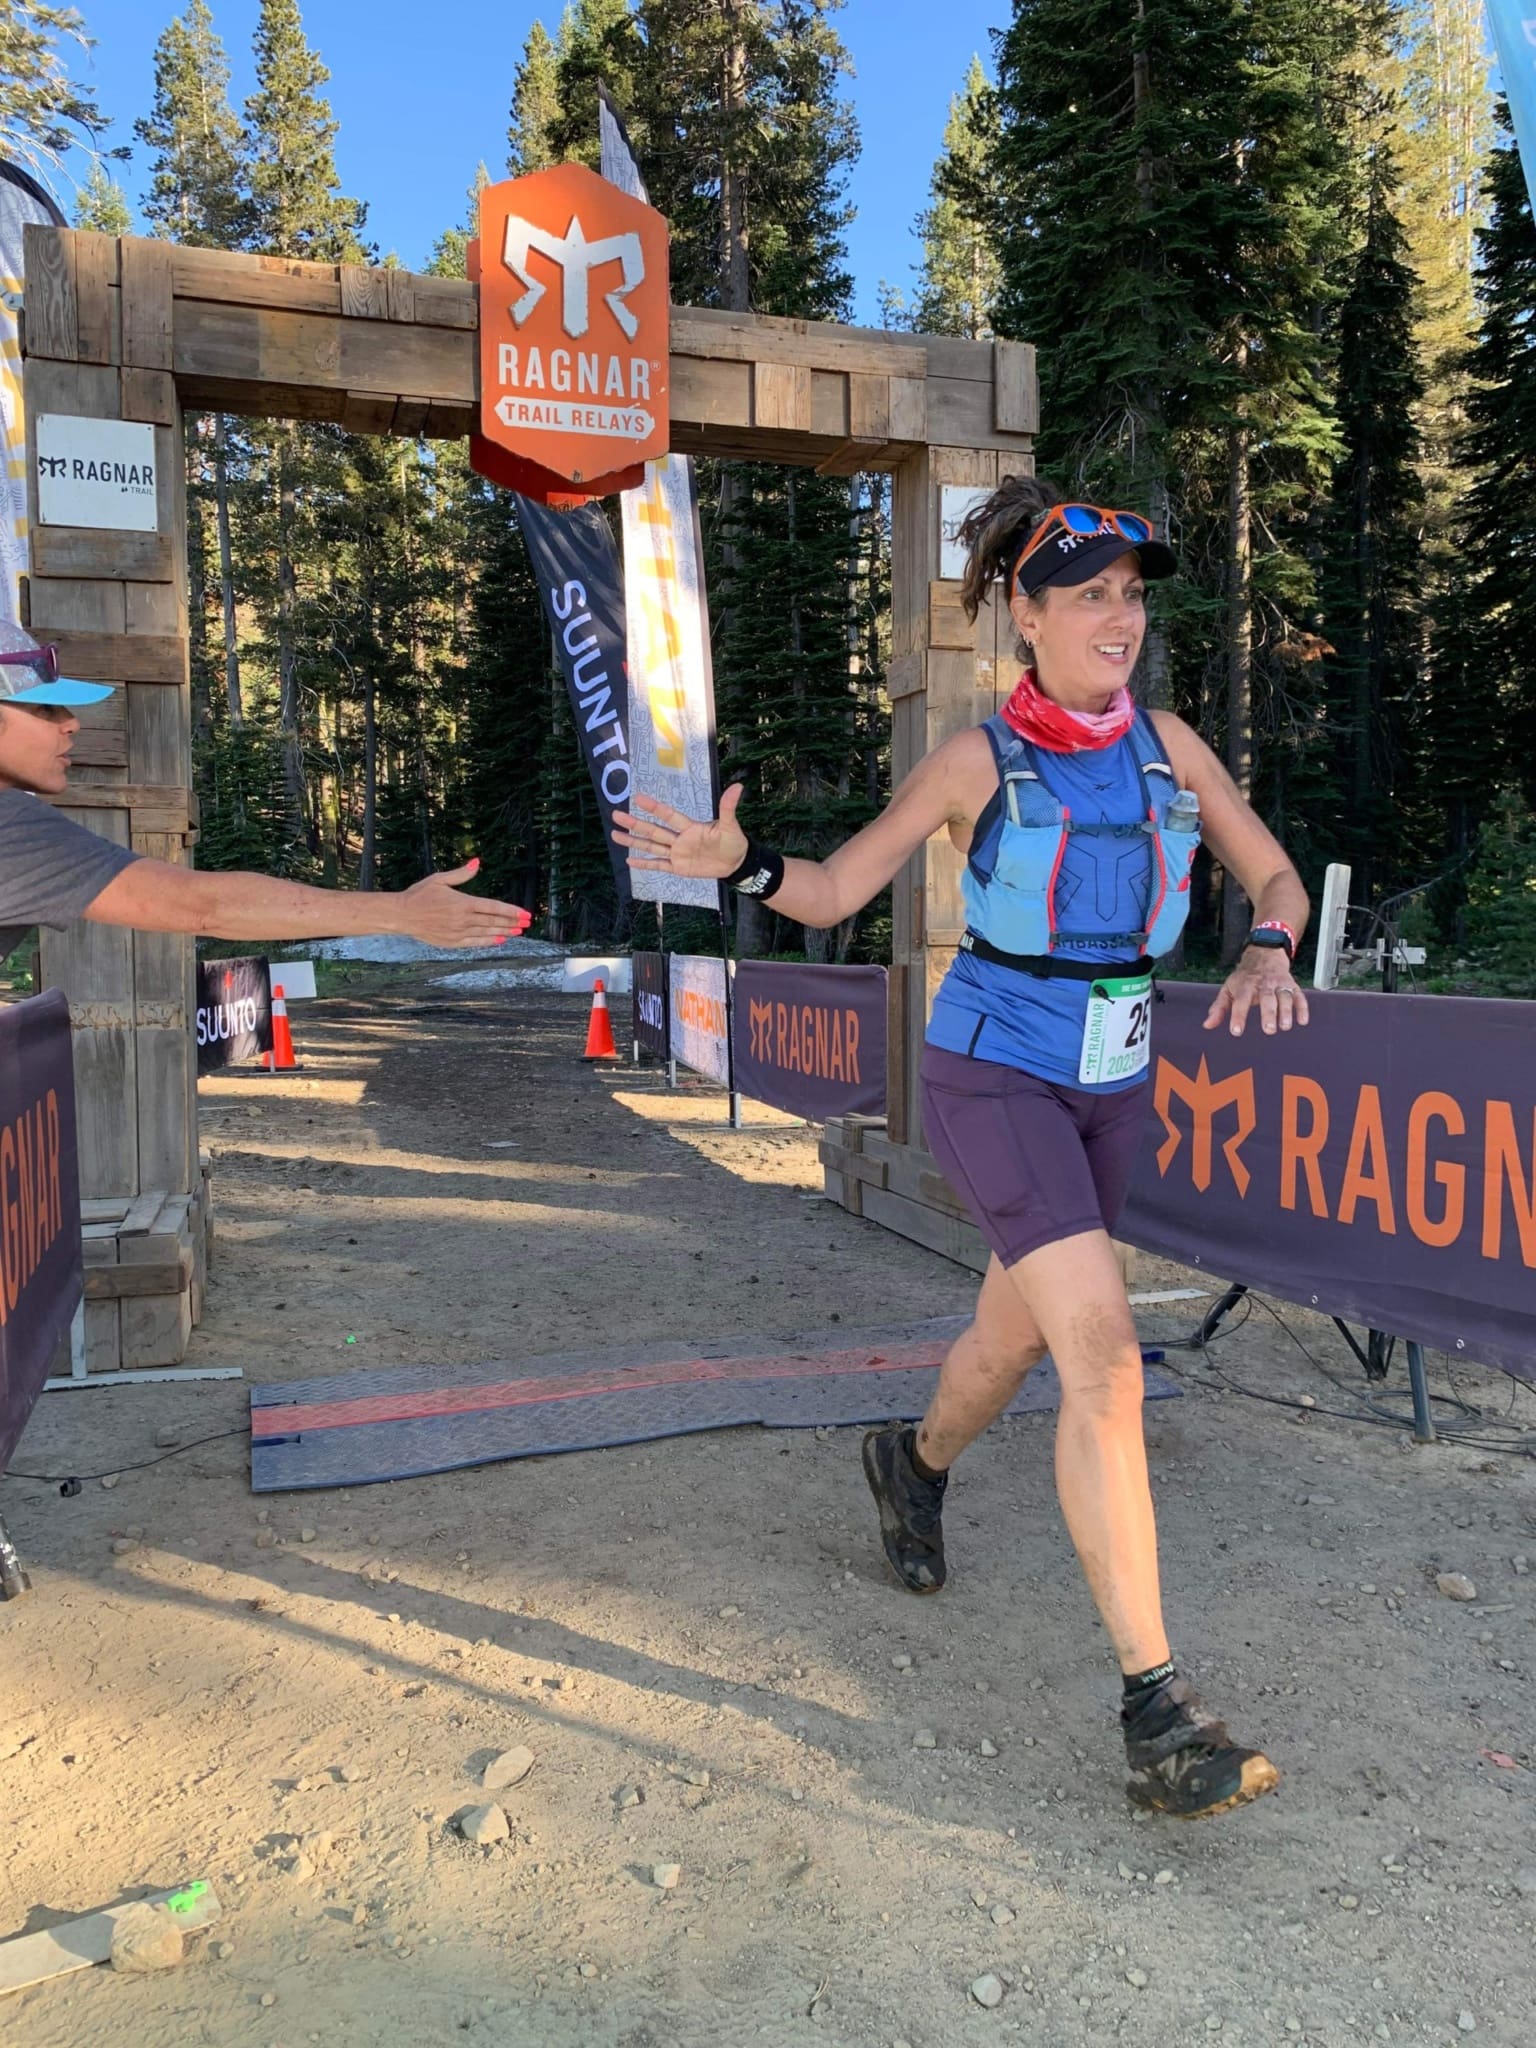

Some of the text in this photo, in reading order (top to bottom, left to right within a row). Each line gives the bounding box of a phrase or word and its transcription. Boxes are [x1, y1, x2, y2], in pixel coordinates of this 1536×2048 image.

[498, 343, 651, 400] RAGNAR
[504, 402, 645, 432] TRAIL RELAYS
[73, 459, 154, 486] RAGNAR
[130, 486, 154, 496] TRAIL
[551, 579, 631, 804] SUUNTO
[197, 997, 257, 1046] SUUNTO
[674, 988, 726, 1039] NATHAN
[1088, 1003, 1105, 1053] RAGNAR
[776, 1002, 861, 1085] RAGNAR
[1107, 1052, 1137, 1076] 2023
[1280, 1074, 1536, 1269] RAGN
